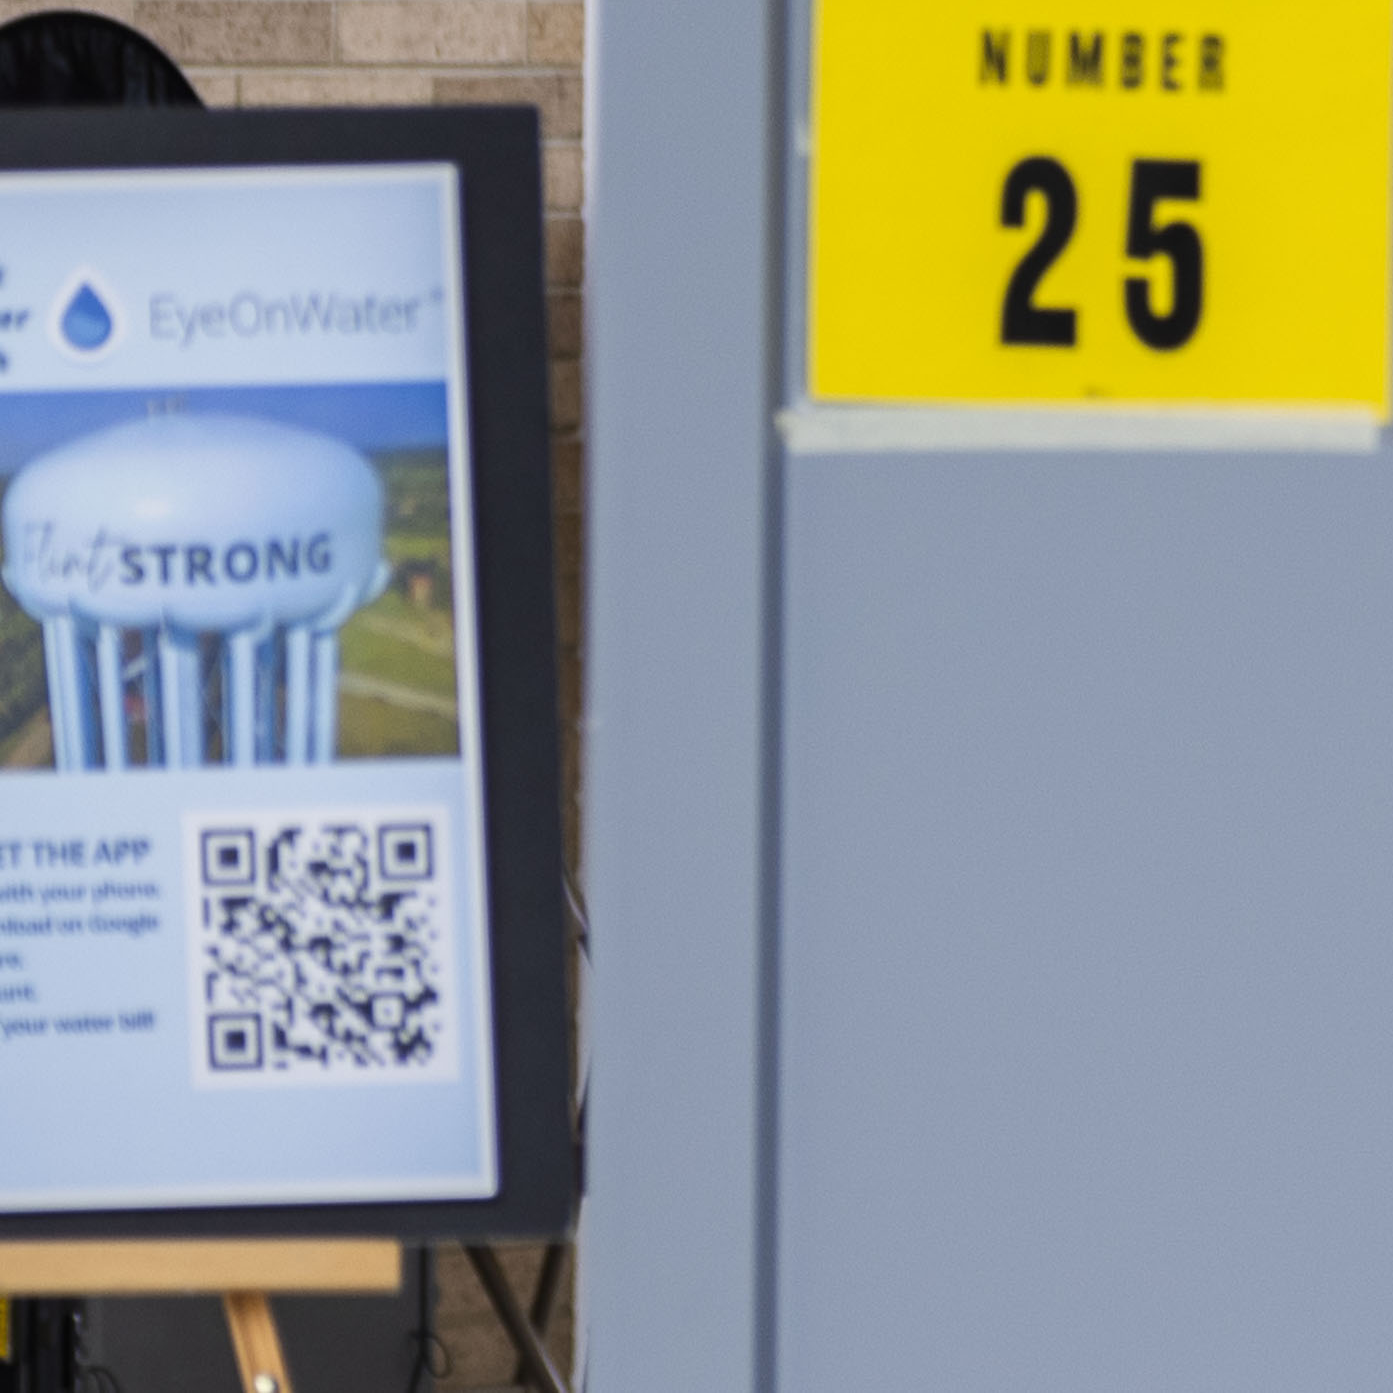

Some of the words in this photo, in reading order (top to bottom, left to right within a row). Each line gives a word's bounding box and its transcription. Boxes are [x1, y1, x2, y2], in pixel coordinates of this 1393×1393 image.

[978, 28, 1229, 93] NUMBER
[998, 154, 1207, 353] 25
[119, 531, 333, 587] STRONG
[34, 841, 85, 867] THE
[95, 837, 151, 864] APP
